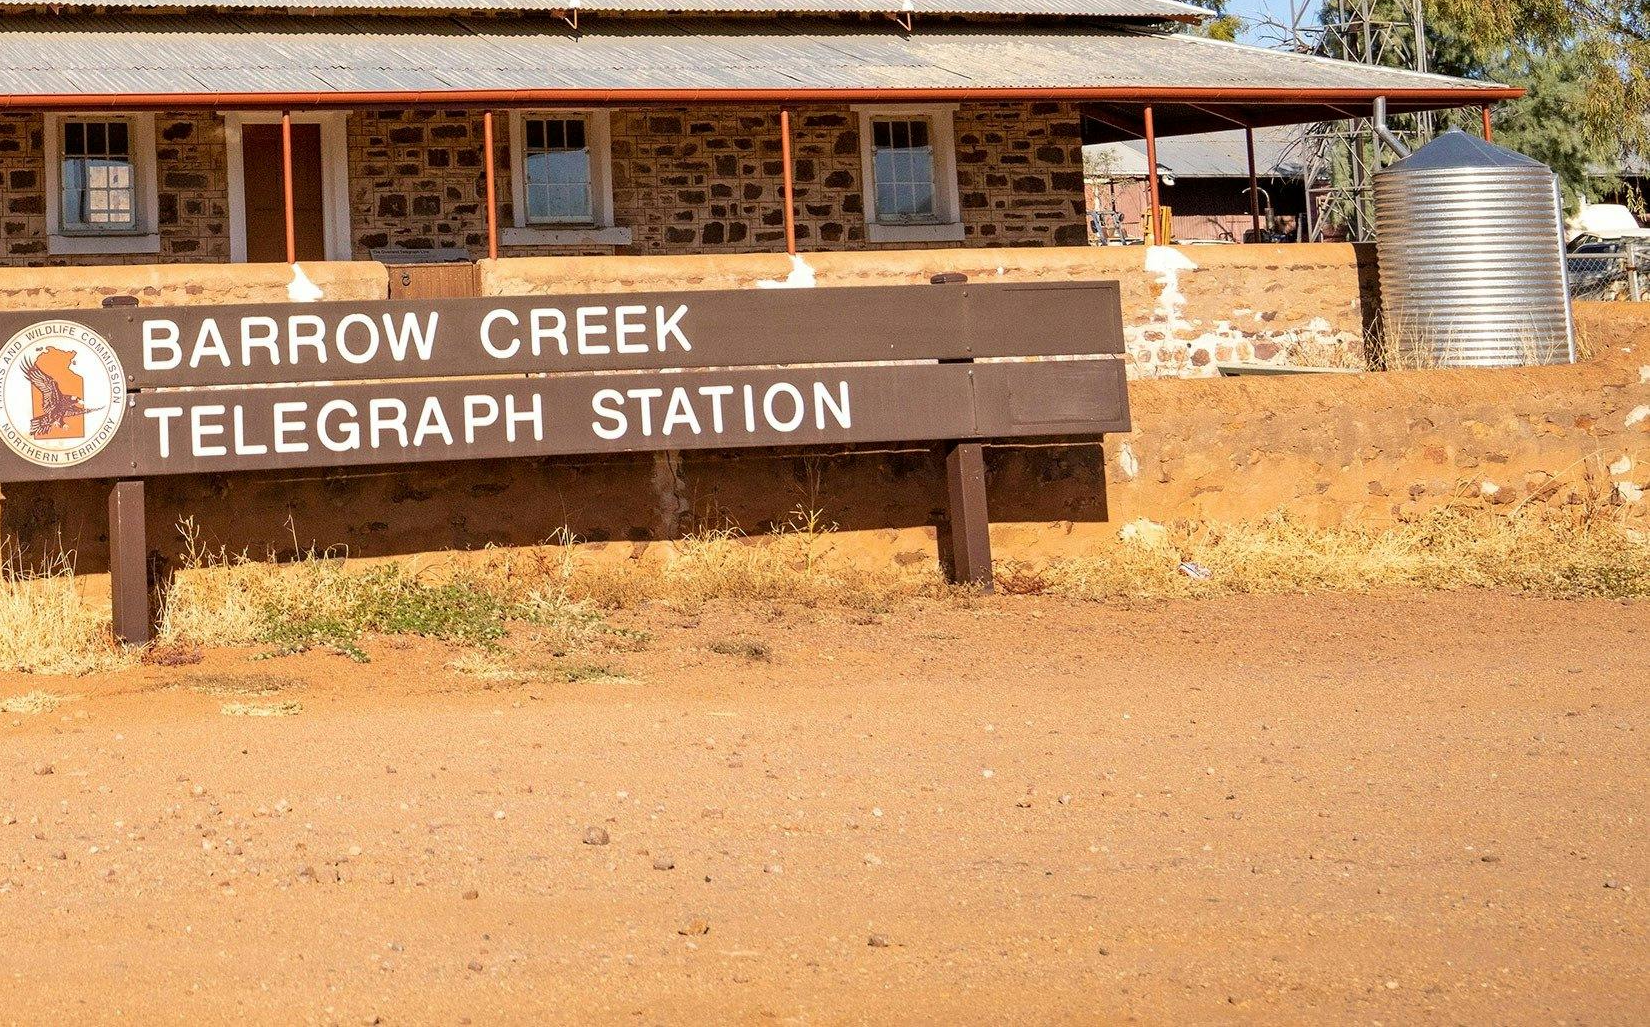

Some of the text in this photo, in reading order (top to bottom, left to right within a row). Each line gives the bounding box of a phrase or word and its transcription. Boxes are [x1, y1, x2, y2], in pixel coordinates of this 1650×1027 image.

[3, 341, 22, 365] AND
[25, 325, 76, 341] WILDLIFE
[81, 332, 121, 404] COMMISSION
[143, 304, 692, 370] BARROW CREEK
[2, 418, 115, 462] NORTHERN TERRITORY
[144, 381, 851, 458] TELEGRAPH STATION
